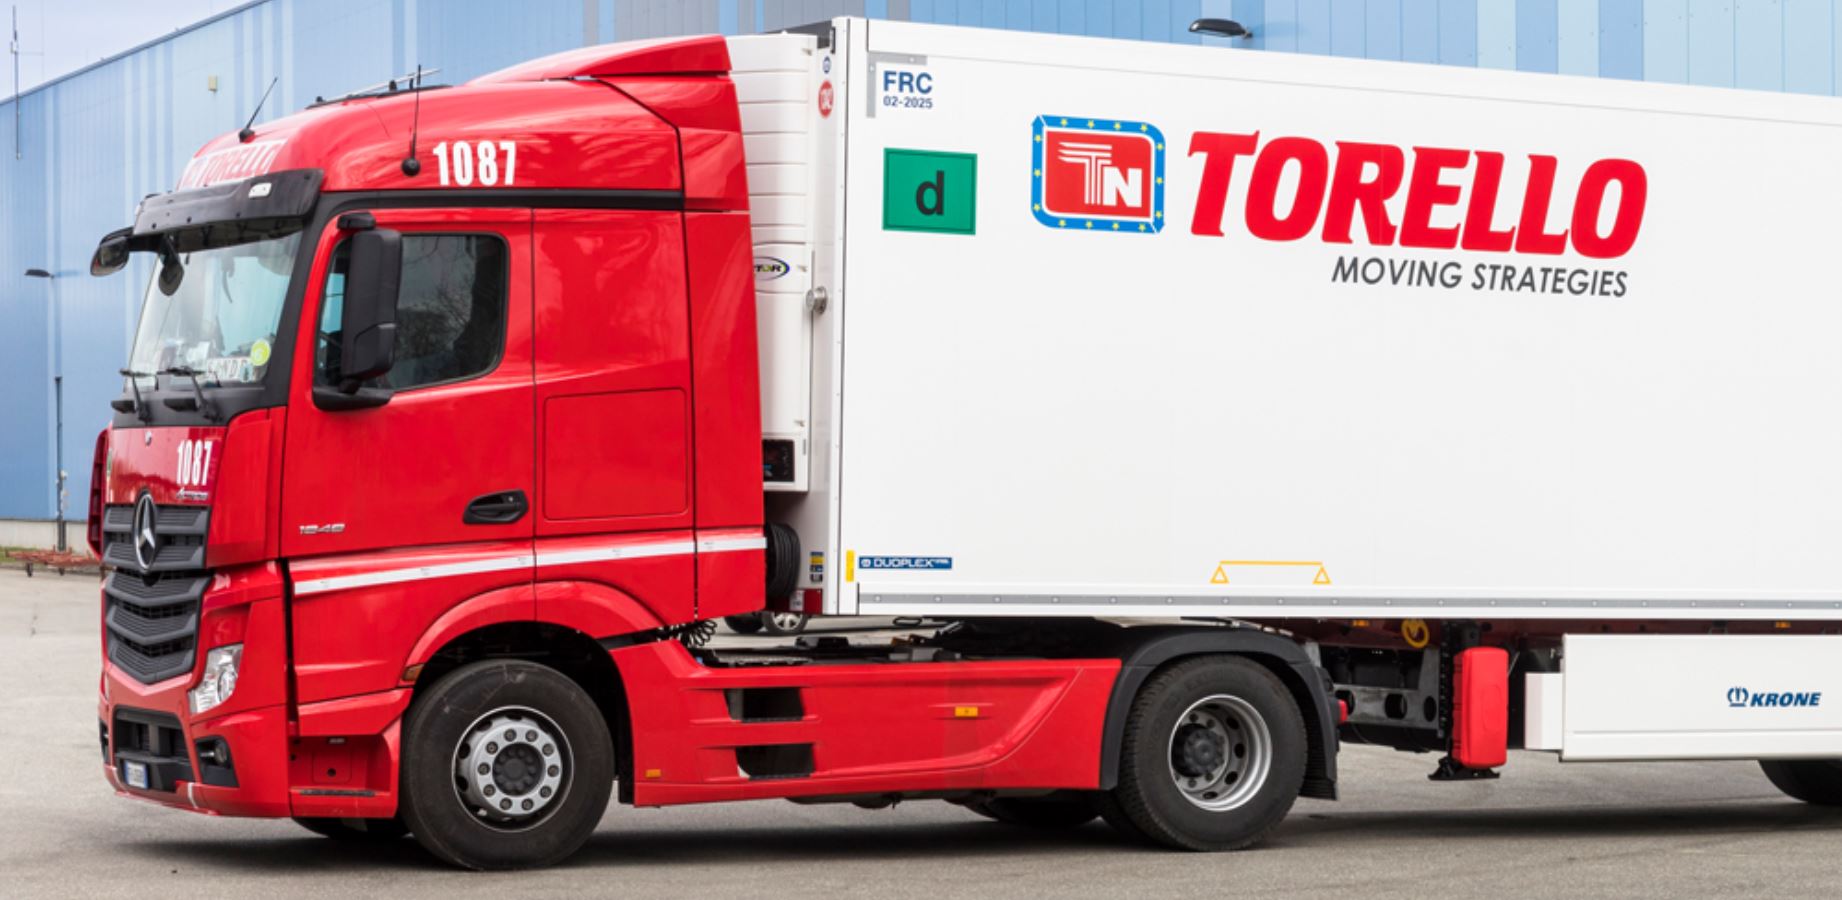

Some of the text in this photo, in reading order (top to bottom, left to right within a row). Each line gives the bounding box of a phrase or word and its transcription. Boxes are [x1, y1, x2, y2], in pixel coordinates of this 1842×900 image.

[883, 70, 932, 94] FRC
[883, 95, 933, 109] 02-2025
[433, 141, 516, 186] 1087
[916, 170, 944, 216] d
[1188, 130, 1648, 259] TORELLO
[1331, 256, 1627, 297] MOVING STRATEGIES
[177, 440, 212, 486] 1087
[873, 559, 933, 568] DUOPLEX
[1750, 692, 1822, 707] KRONE
